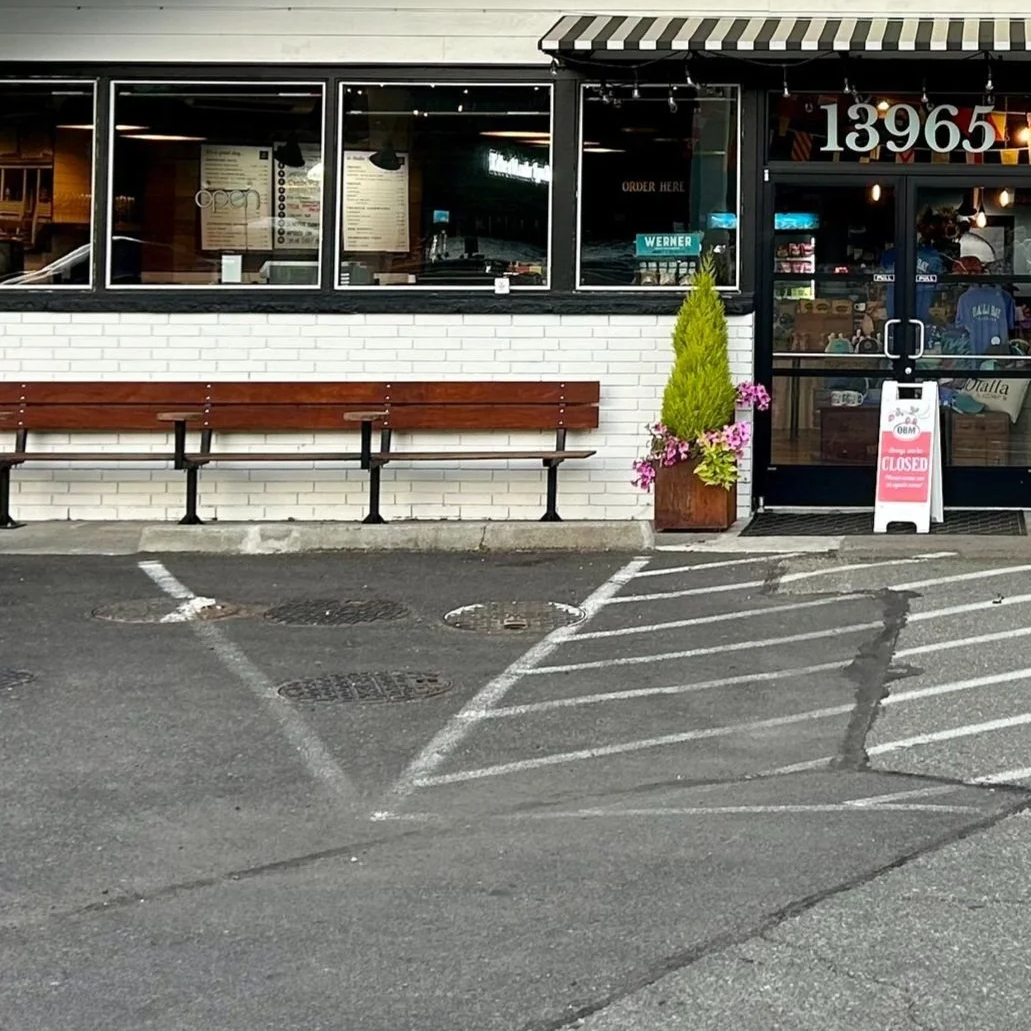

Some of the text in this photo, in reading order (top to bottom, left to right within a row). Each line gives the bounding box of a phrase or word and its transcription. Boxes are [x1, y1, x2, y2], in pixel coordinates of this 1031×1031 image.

[819, 103, 996, 153] 13965
[622, 181, 686, 193] ORDER HERE
[195, 190, 260, 214] open
[644, 236, 692, 247] WERNER
[882, 456, 928, 472] CLOSED
